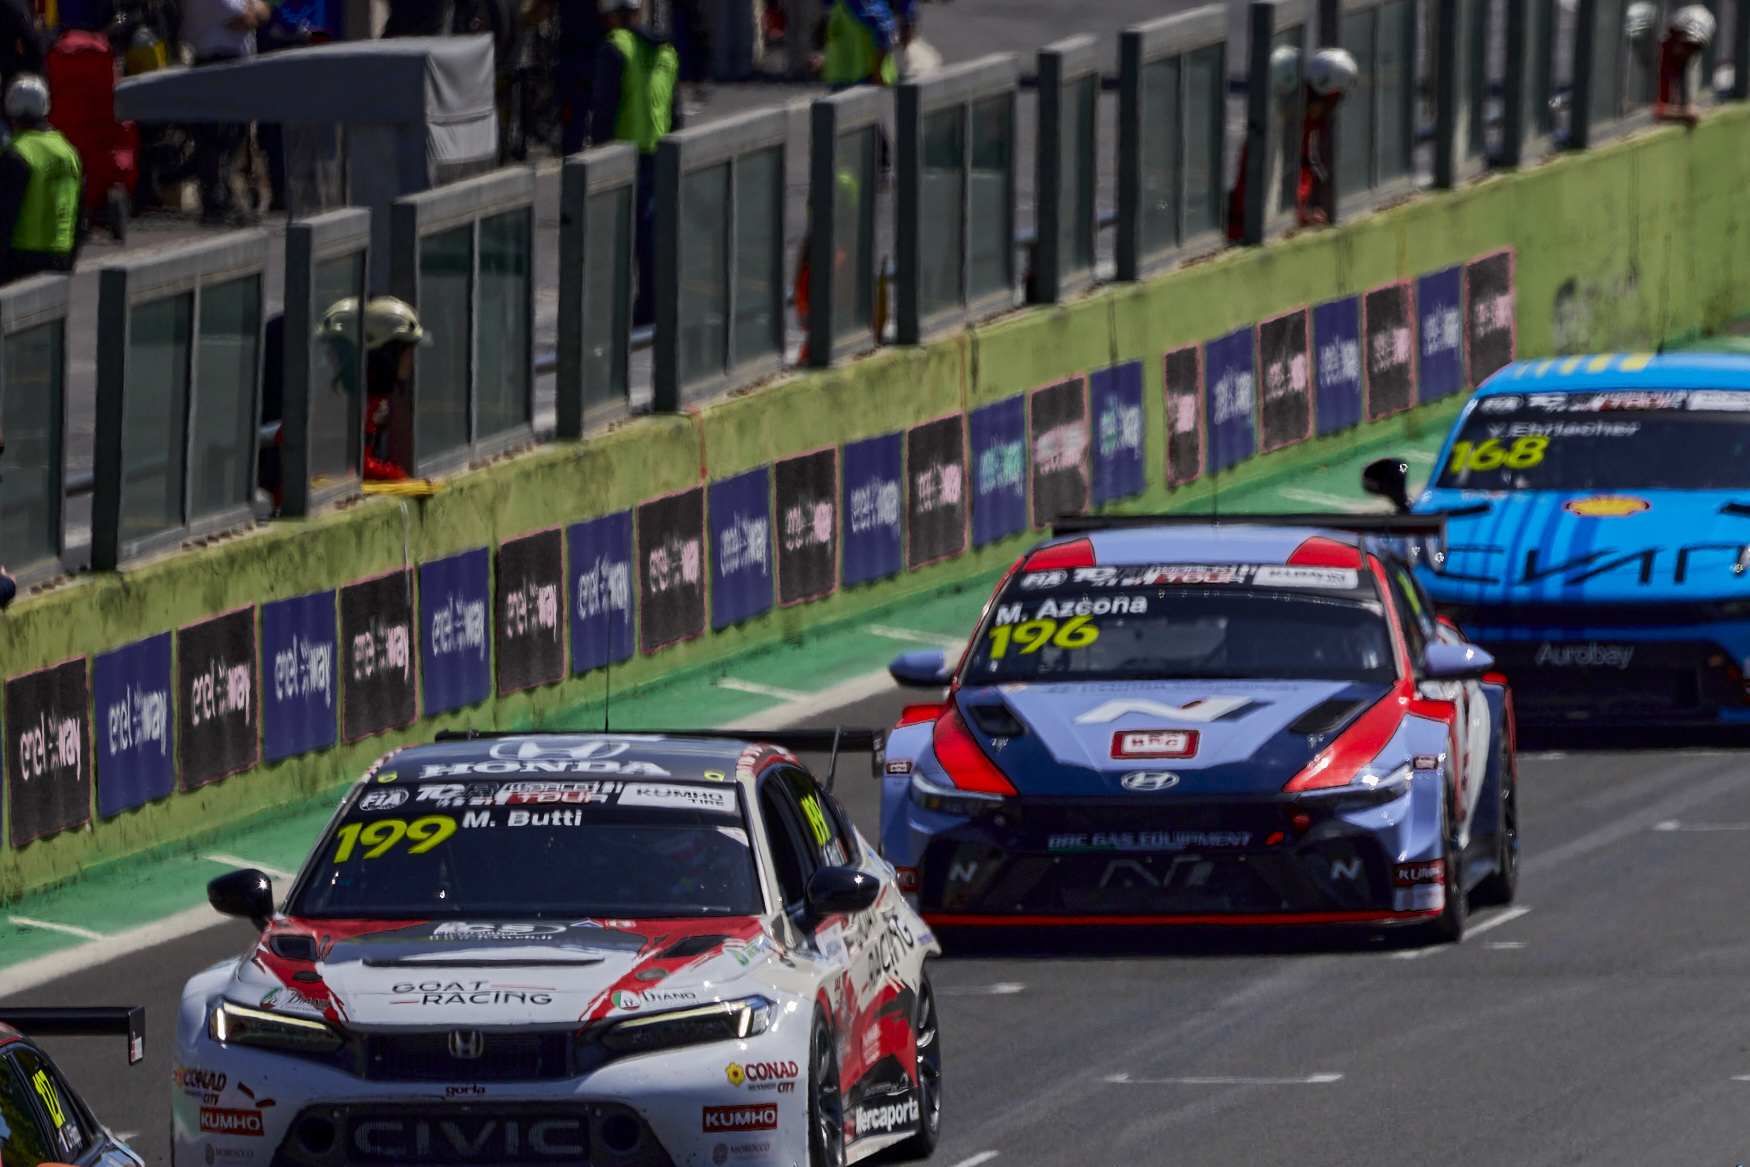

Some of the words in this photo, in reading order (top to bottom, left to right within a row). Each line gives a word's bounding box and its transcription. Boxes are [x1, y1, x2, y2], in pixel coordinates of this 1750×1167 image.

[1450, 434, 1549, 473] 168
[995, 603, 1027, 625] M.
[1036, 596, 1147, 618] Azcona
[989, 615, 1100, 660] 196
[419, 759, 671, 779] HONDA
[636, 788, 724, 800] KUMHO
[462, 811, 496, 829] M.
[507, 809, 583, 828] Butti
[333, 814, 458, 864] 199
[392, 980, 490, 993] GOAT
[422, 991, 553, 1006] RACING
[745, 1061, 799, 1082] CONAD
[200, 1111, 260, 1131] KUMHO
[706, 1109, 776, 1128] KUMHO
[354, 1120, 583, 1156] CIVIC
